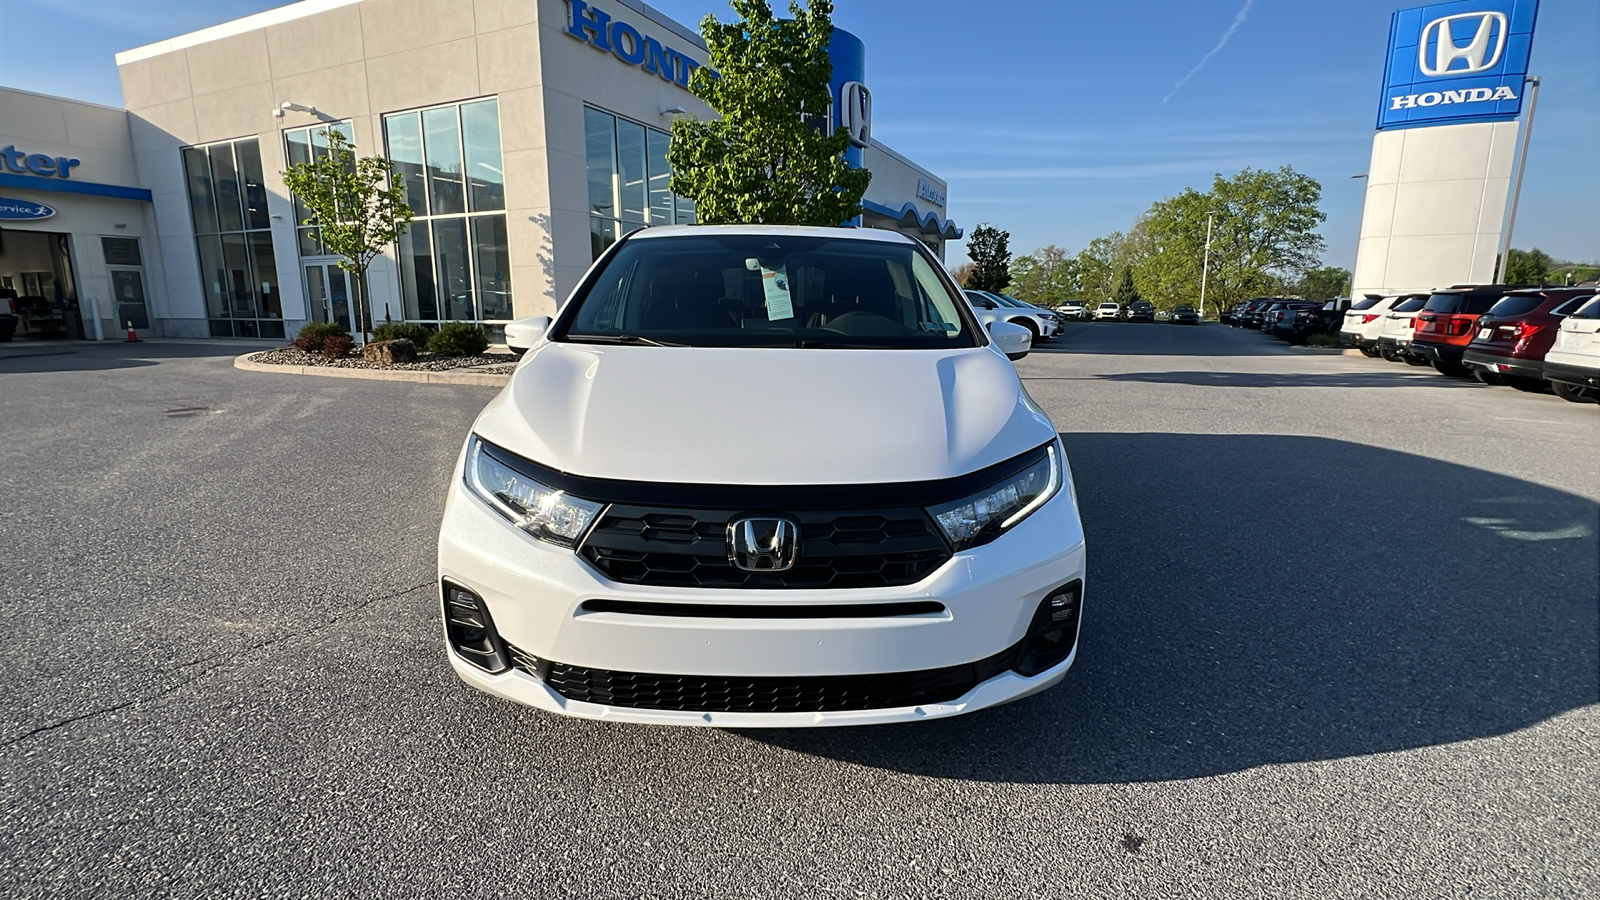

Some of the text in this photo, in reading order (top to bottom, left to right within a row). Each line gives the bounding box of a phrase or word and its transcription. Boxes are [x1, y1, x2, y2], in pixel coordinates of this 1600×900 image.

[563, 0, 723, 89] HOND
[1390, 86, 1518, 110] HONDA
[0, 145, 80, 178] ter
